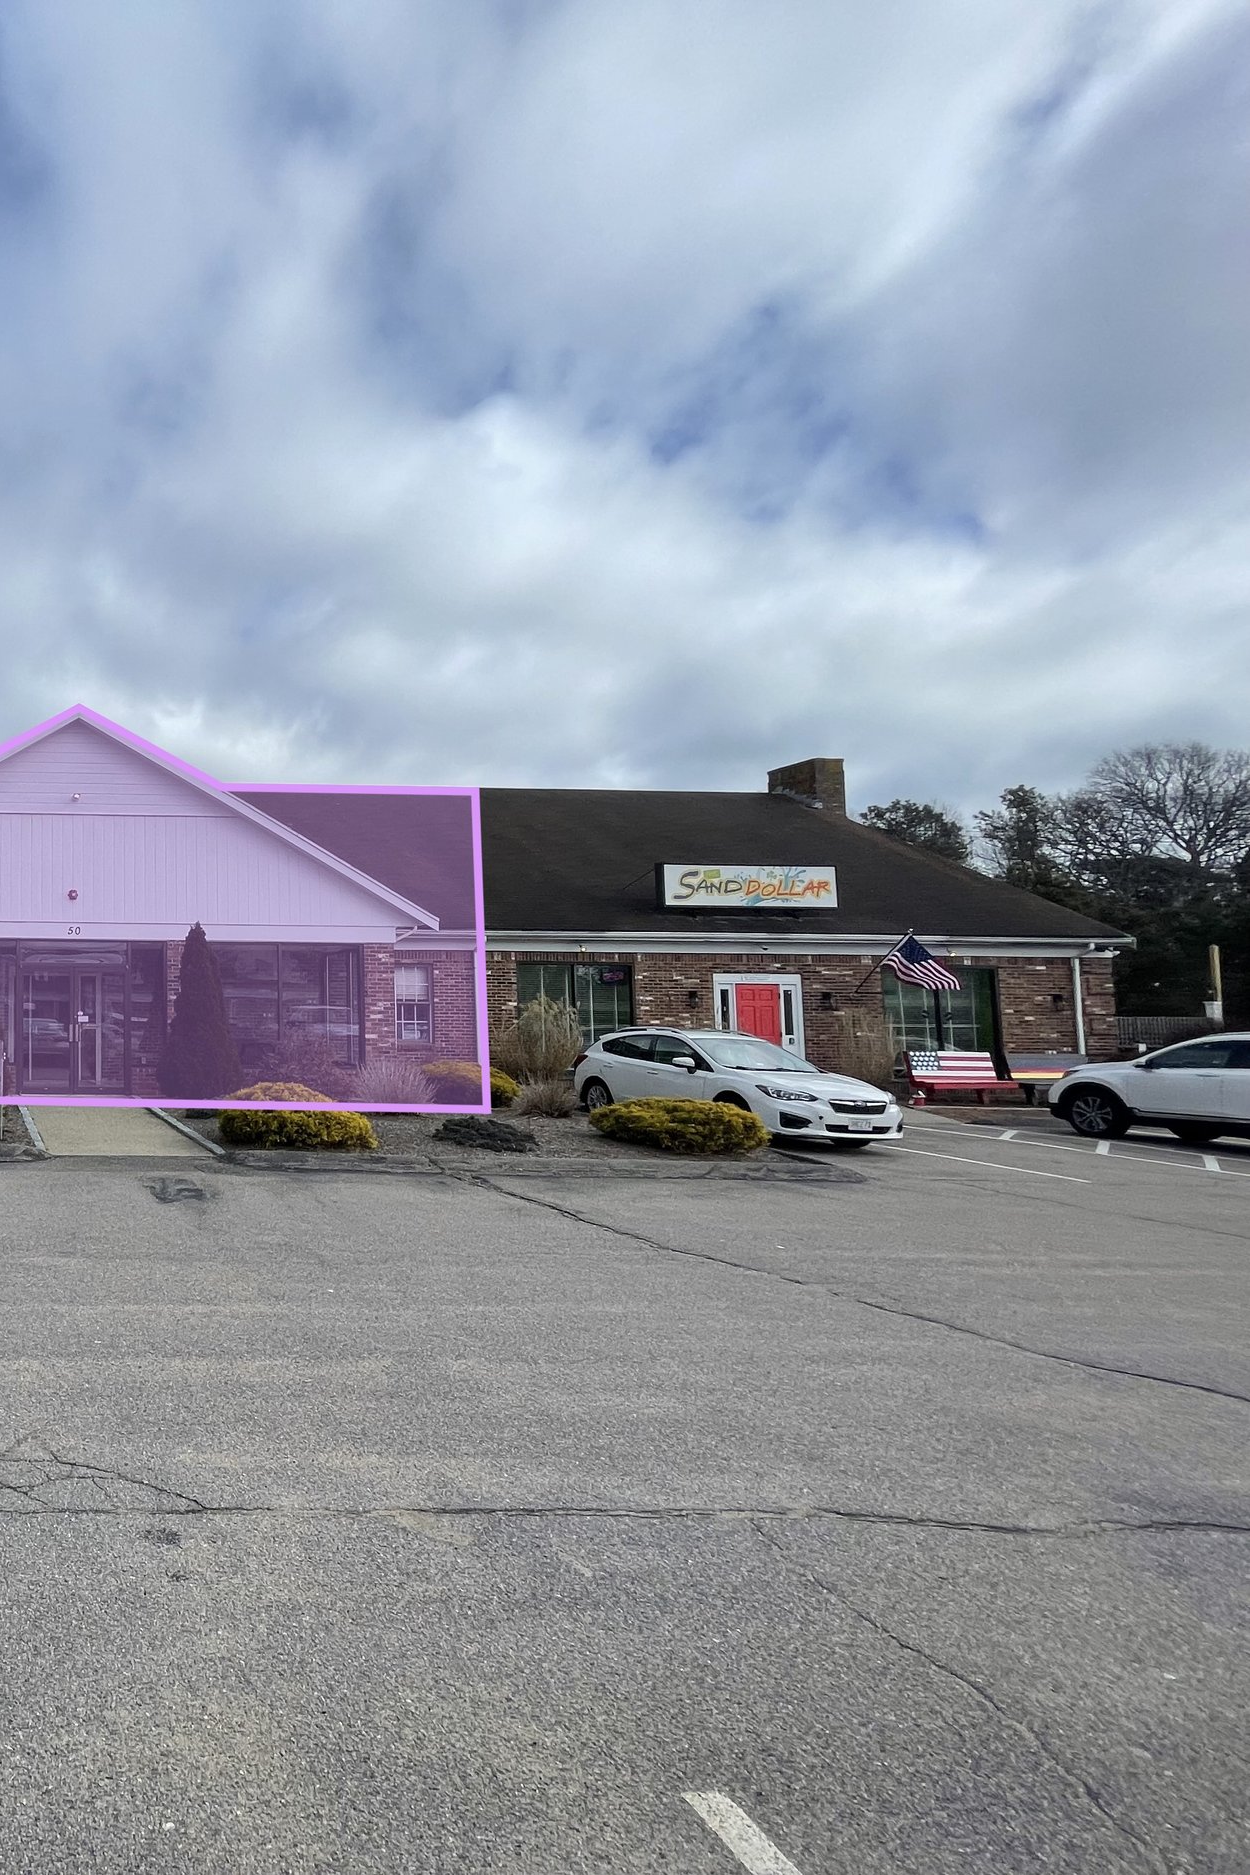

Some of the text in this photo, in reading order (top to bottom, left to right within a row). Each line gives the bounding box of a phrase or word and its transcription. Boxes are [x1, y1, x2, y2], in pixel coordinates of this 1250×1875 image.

[673, 870, 743, 900] SAND
[745, 880, 830, 897] DOLLAR
[67, 926, 81, 935] 50
